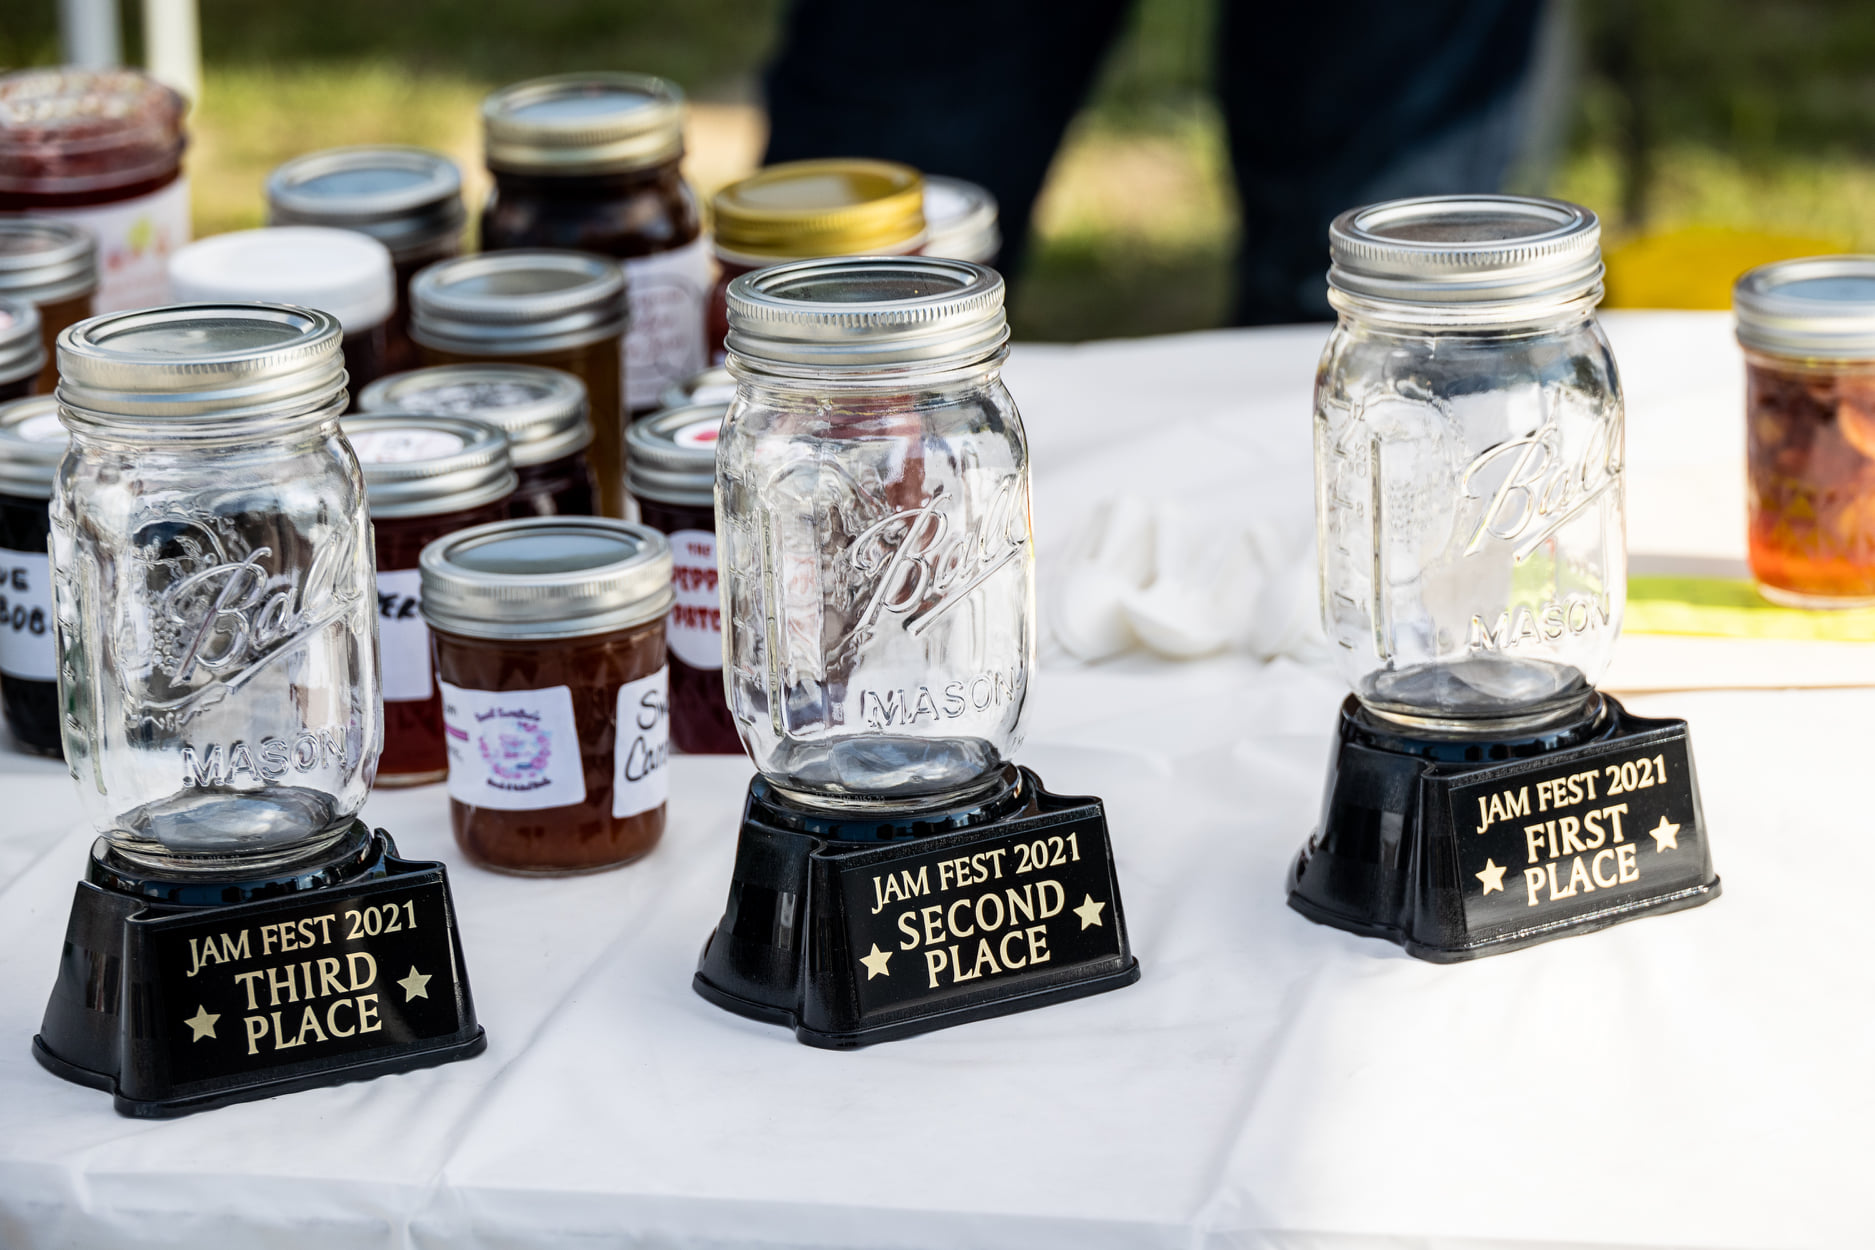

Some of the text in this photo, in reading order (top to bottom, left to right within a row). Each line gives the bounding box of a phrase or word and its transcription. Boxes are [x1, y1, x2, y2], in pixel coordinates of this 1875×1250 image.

[1461, 402, 1622, 563] Ball
[848, 464, 1031, 636] Ball
[160, 521, 365, 693] Ball
[1467, 594, 1611, 650] MASON
[865, 667, 1015, 729] MASON
[181, 727, 348, 787] MASON
[1476, 753, 1668, 835] JAM FEST 2021
[1523, 802, 1629, 864] FIRST
[871, 831, 1081, 915] JAM FEST 2021
[1523, 842, 1640, 907] PLACE
[186, 899, 417, 977] JAM FEST 2021
[897, 879, 1065, 951] SECOND
[234, 951, 378, 1010] THIRD
[924, 924, 1051, 989] PLACE
[243, 993, 382, 1055] PLACE
